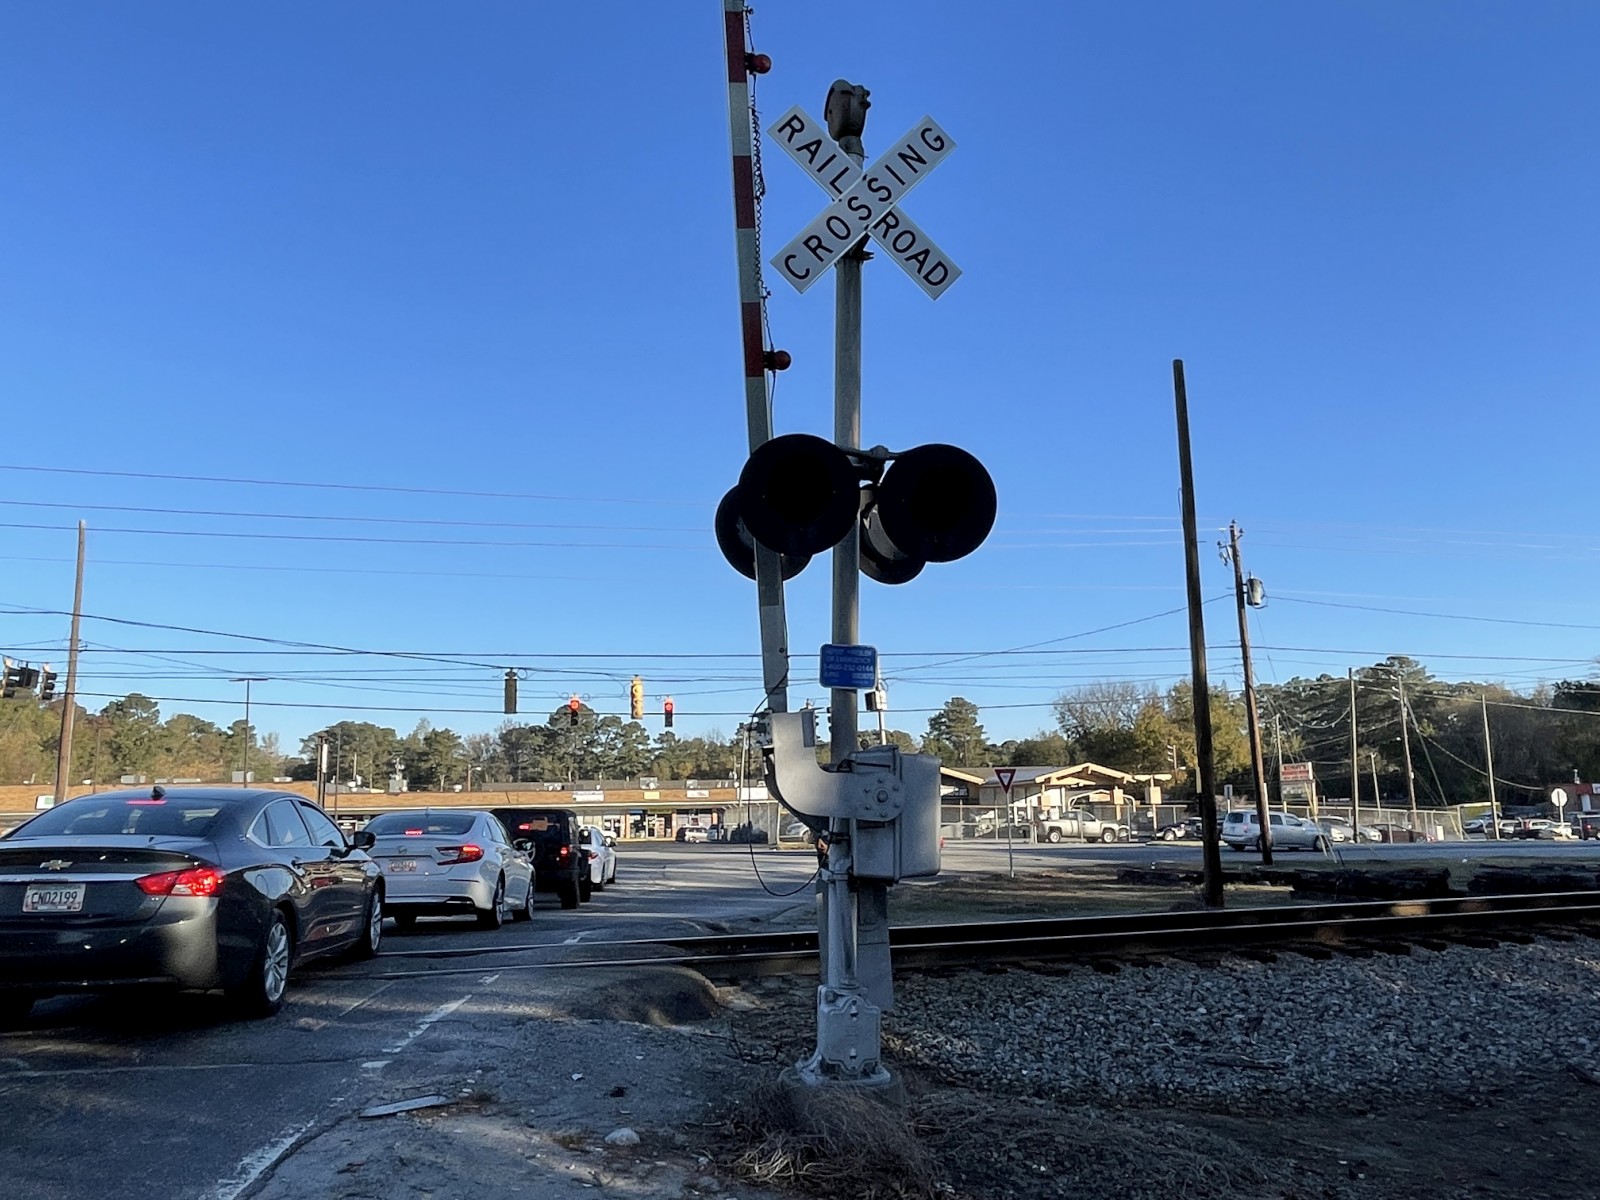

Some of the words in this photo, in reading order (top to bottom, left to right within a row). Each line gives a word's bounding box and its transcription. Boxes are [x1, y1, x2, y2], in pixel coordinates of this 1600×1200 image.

[777, 114, 850, 195] RAIL
[872, 209, 949, 287] ROAD
[784, 127, 945, 280] CROSSING
